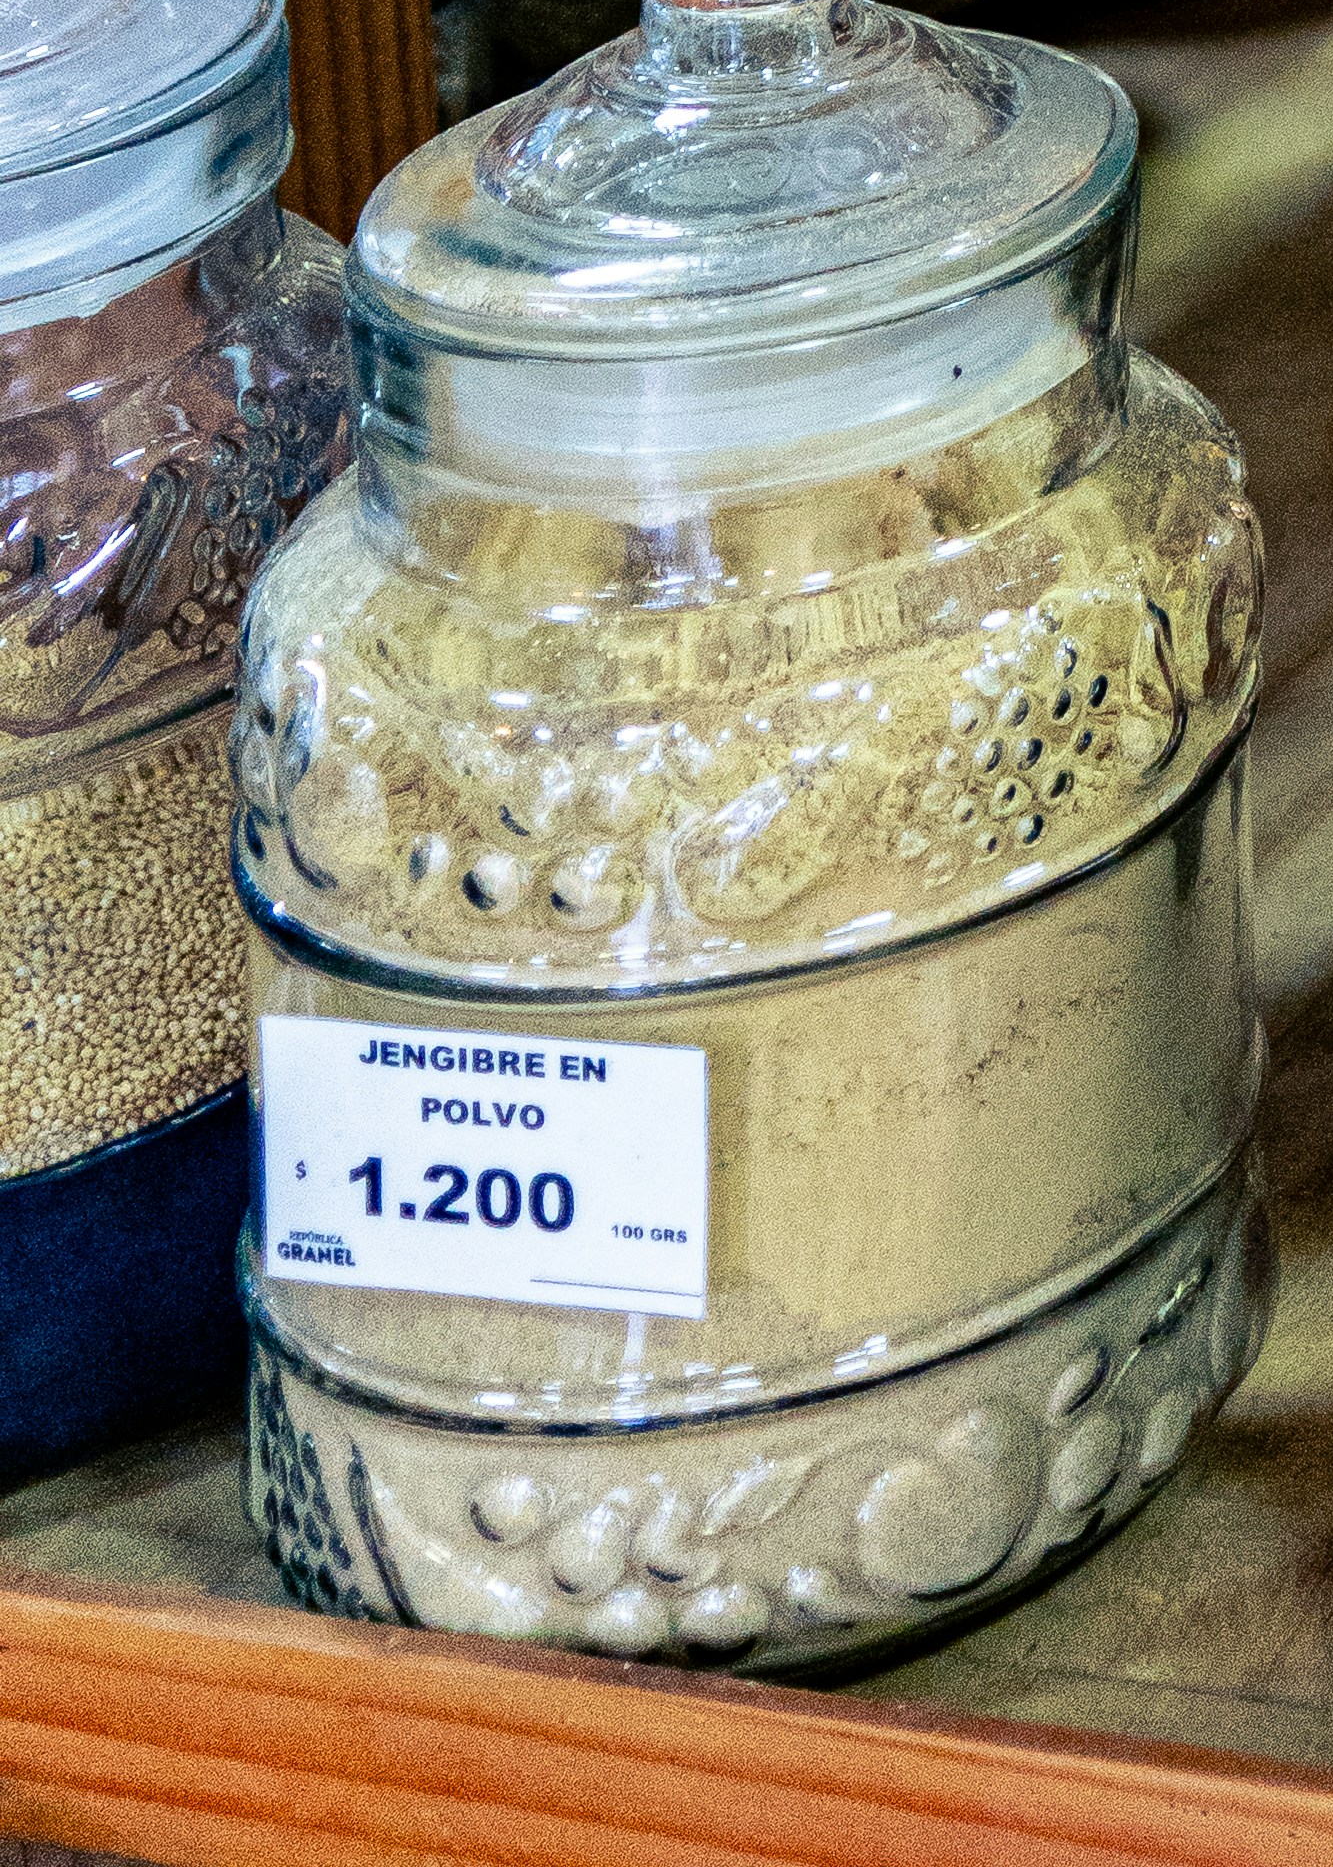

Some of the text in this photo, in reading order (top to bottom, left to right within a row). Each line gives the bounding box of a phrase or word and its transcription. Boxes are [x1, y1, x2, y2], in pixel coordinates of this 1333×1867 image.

[358, 1040, 608, 1083] JENGIBRE EN
[421, 1096, 546, 1131] POLVO
[294, 1155, 576, 1233] $ 1.200
[610, 1224, 688, 1245] 100 GRS
[277, 1241, 357, 1268] GRANEL
